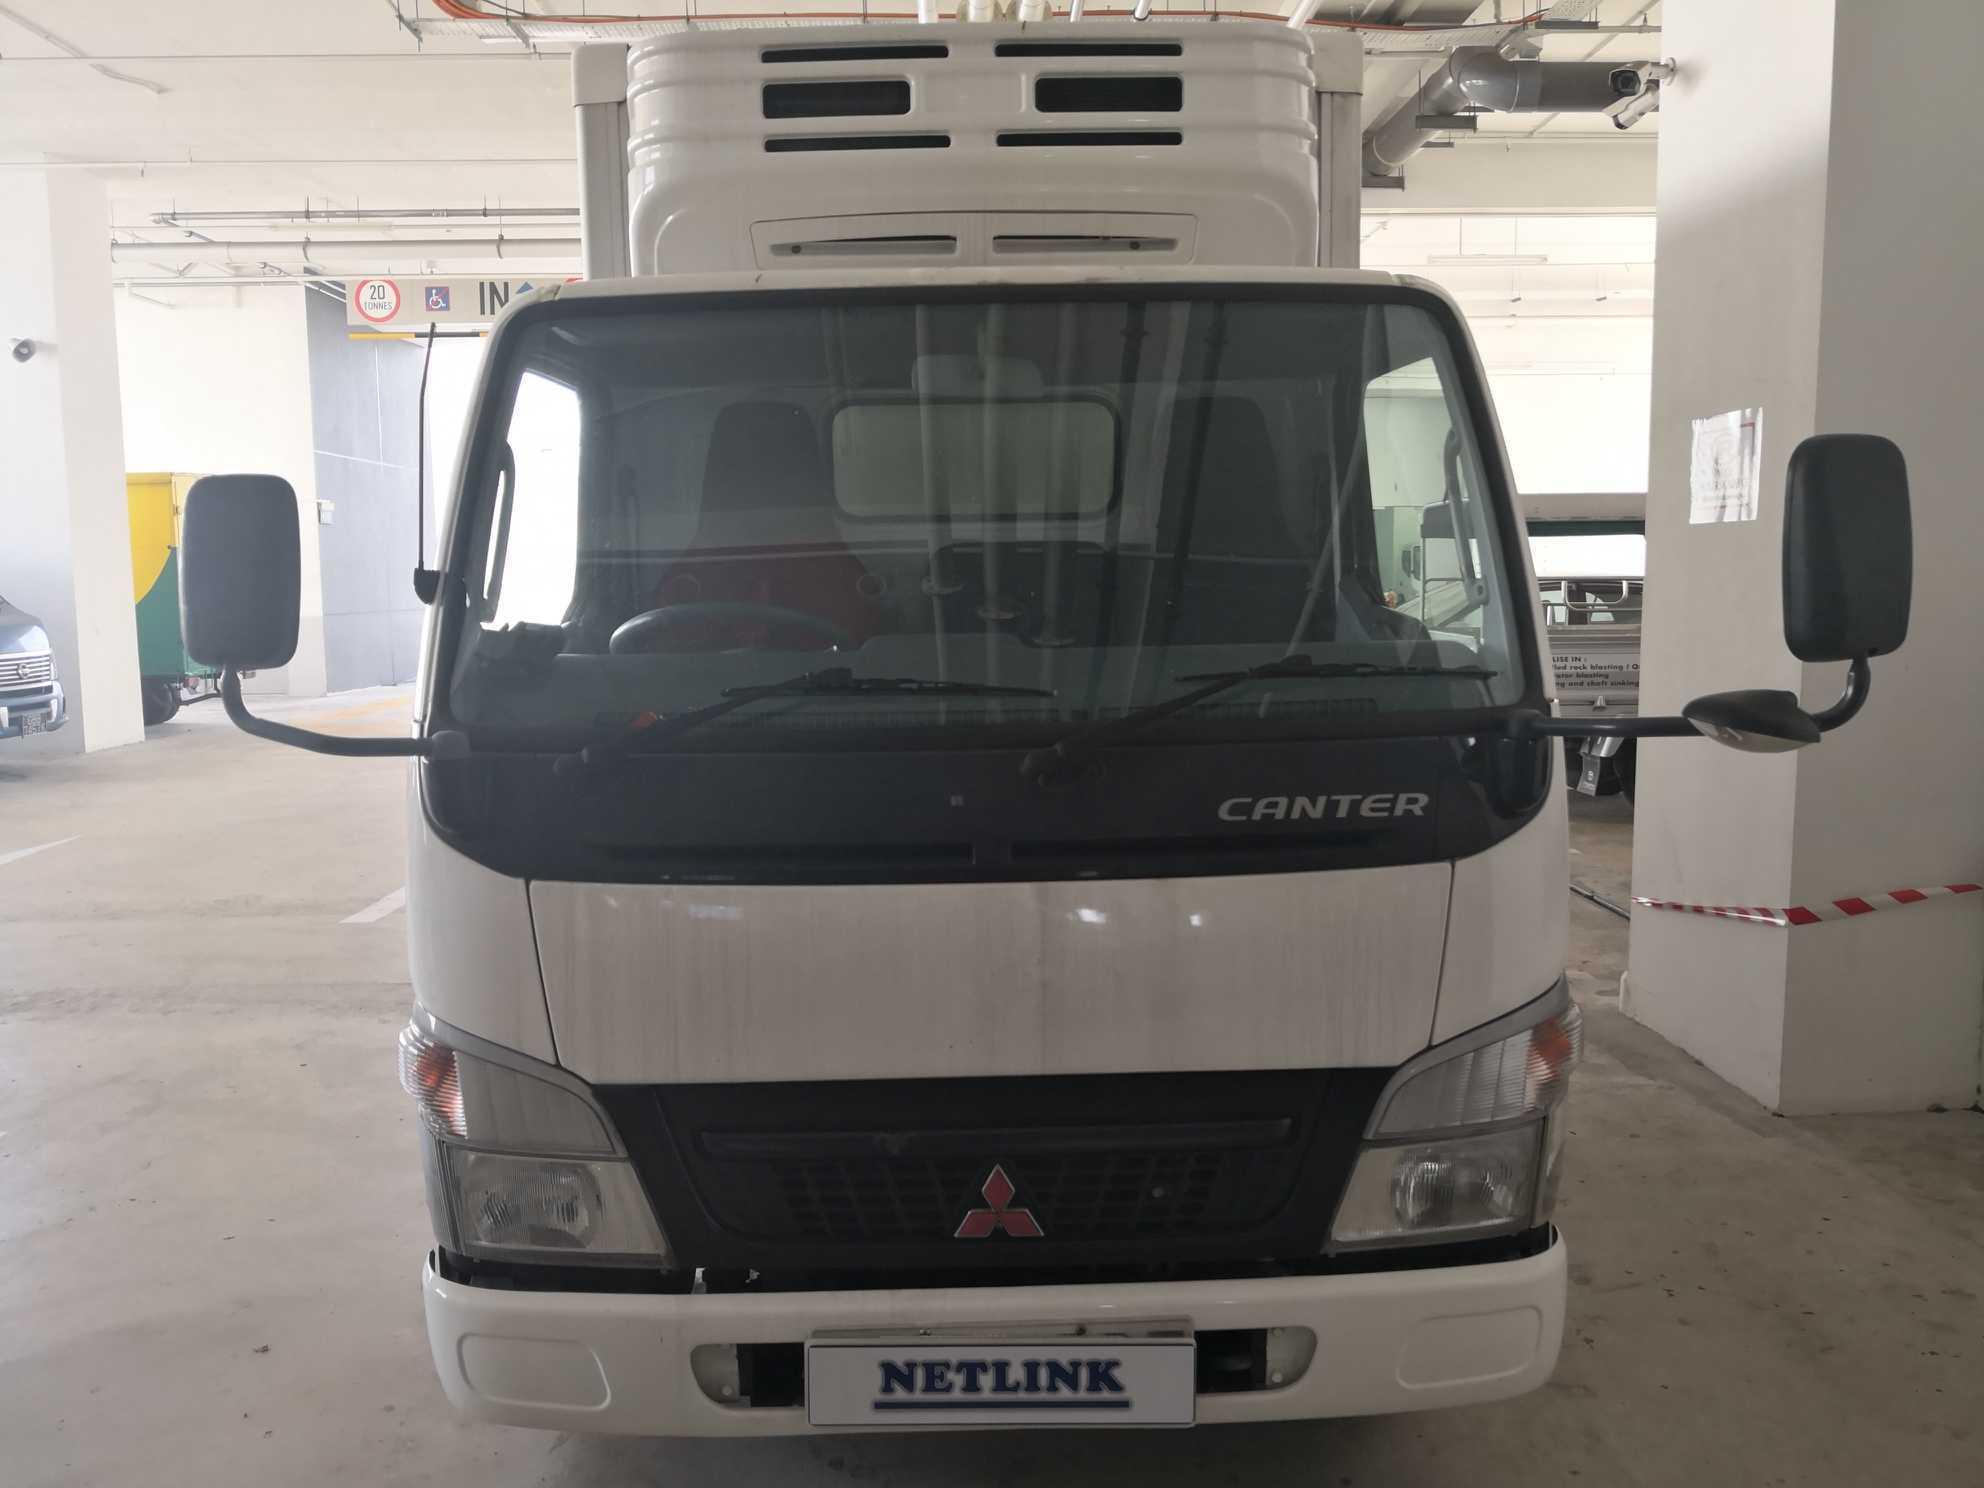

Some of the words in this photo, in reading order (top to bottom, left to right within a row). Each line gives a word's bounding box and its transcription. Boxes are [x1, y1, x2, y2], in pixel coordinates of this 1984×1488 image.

[370, 285, 386, 300] 20
[479, 281, 509, 315] IN
[364, 302, 393, 310] TONNES
[1590, 664, 1624, 672] blasting
[1217, 792, 1429, 821] CANTER
[878, 1358, 1126, 1394] NETLINK
